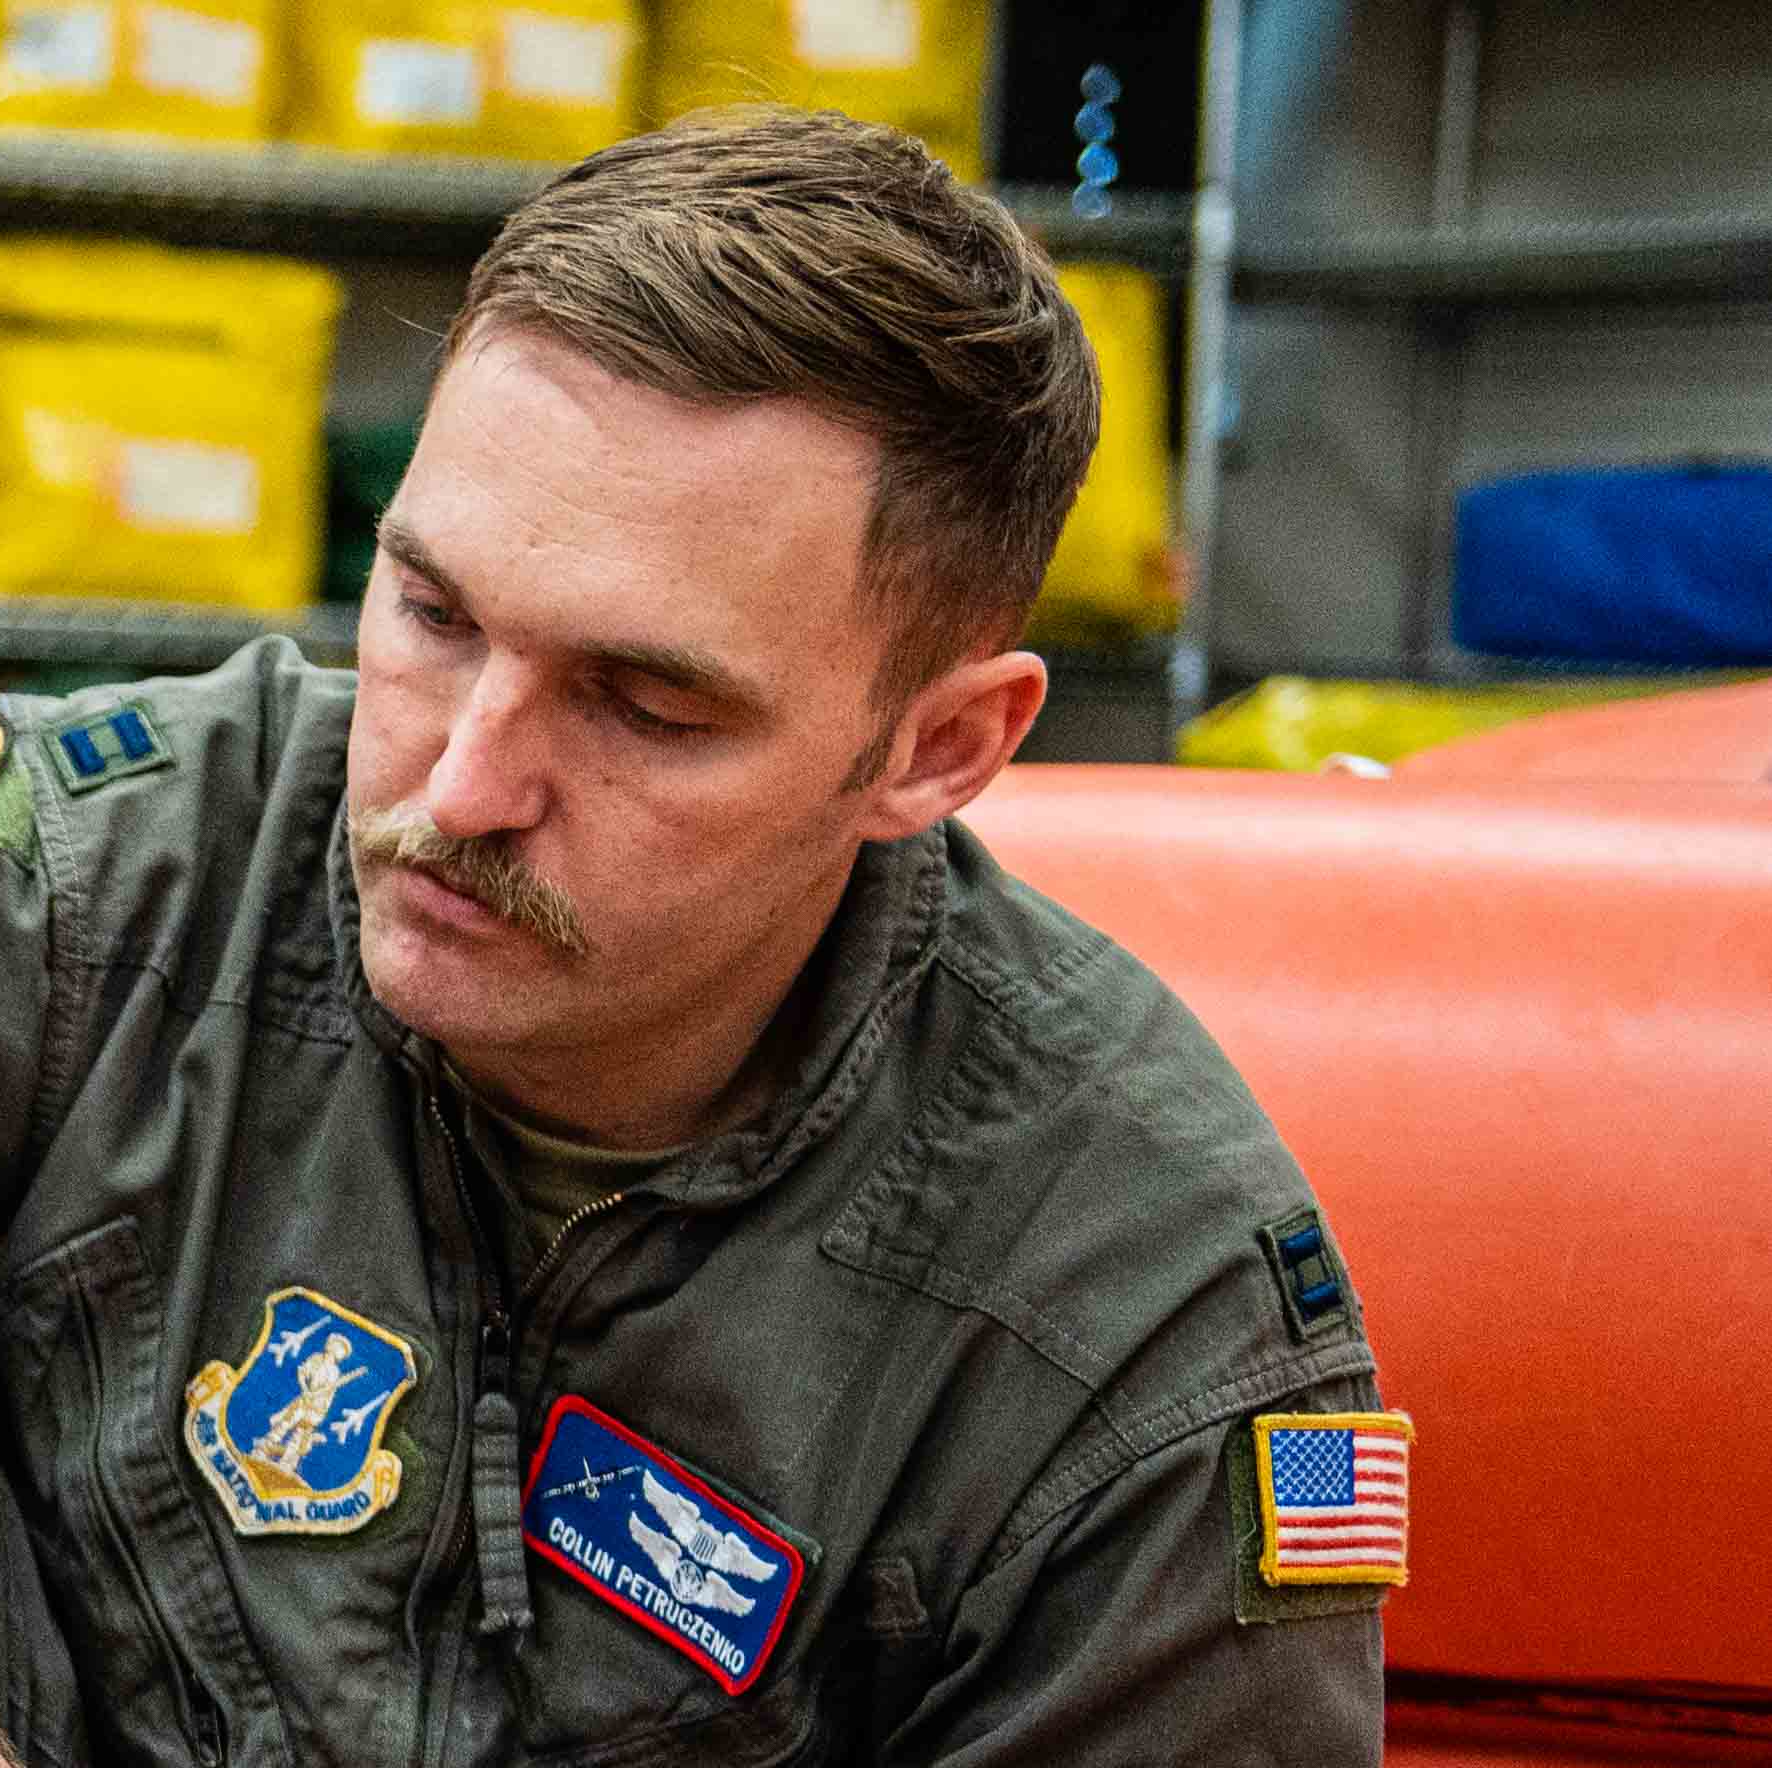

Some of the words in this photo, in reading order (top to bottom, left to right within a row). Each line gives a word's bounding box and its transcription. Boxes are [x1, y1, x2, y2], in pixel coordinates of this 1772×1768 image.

[211, 1447, 302, 1522] NATIONAL
[306, 1490, 372, 1522] GUARD
[547, 1516, 616, 1583] COLLIN
[614, 1564, 746, 1676] PETRUCZENKO
